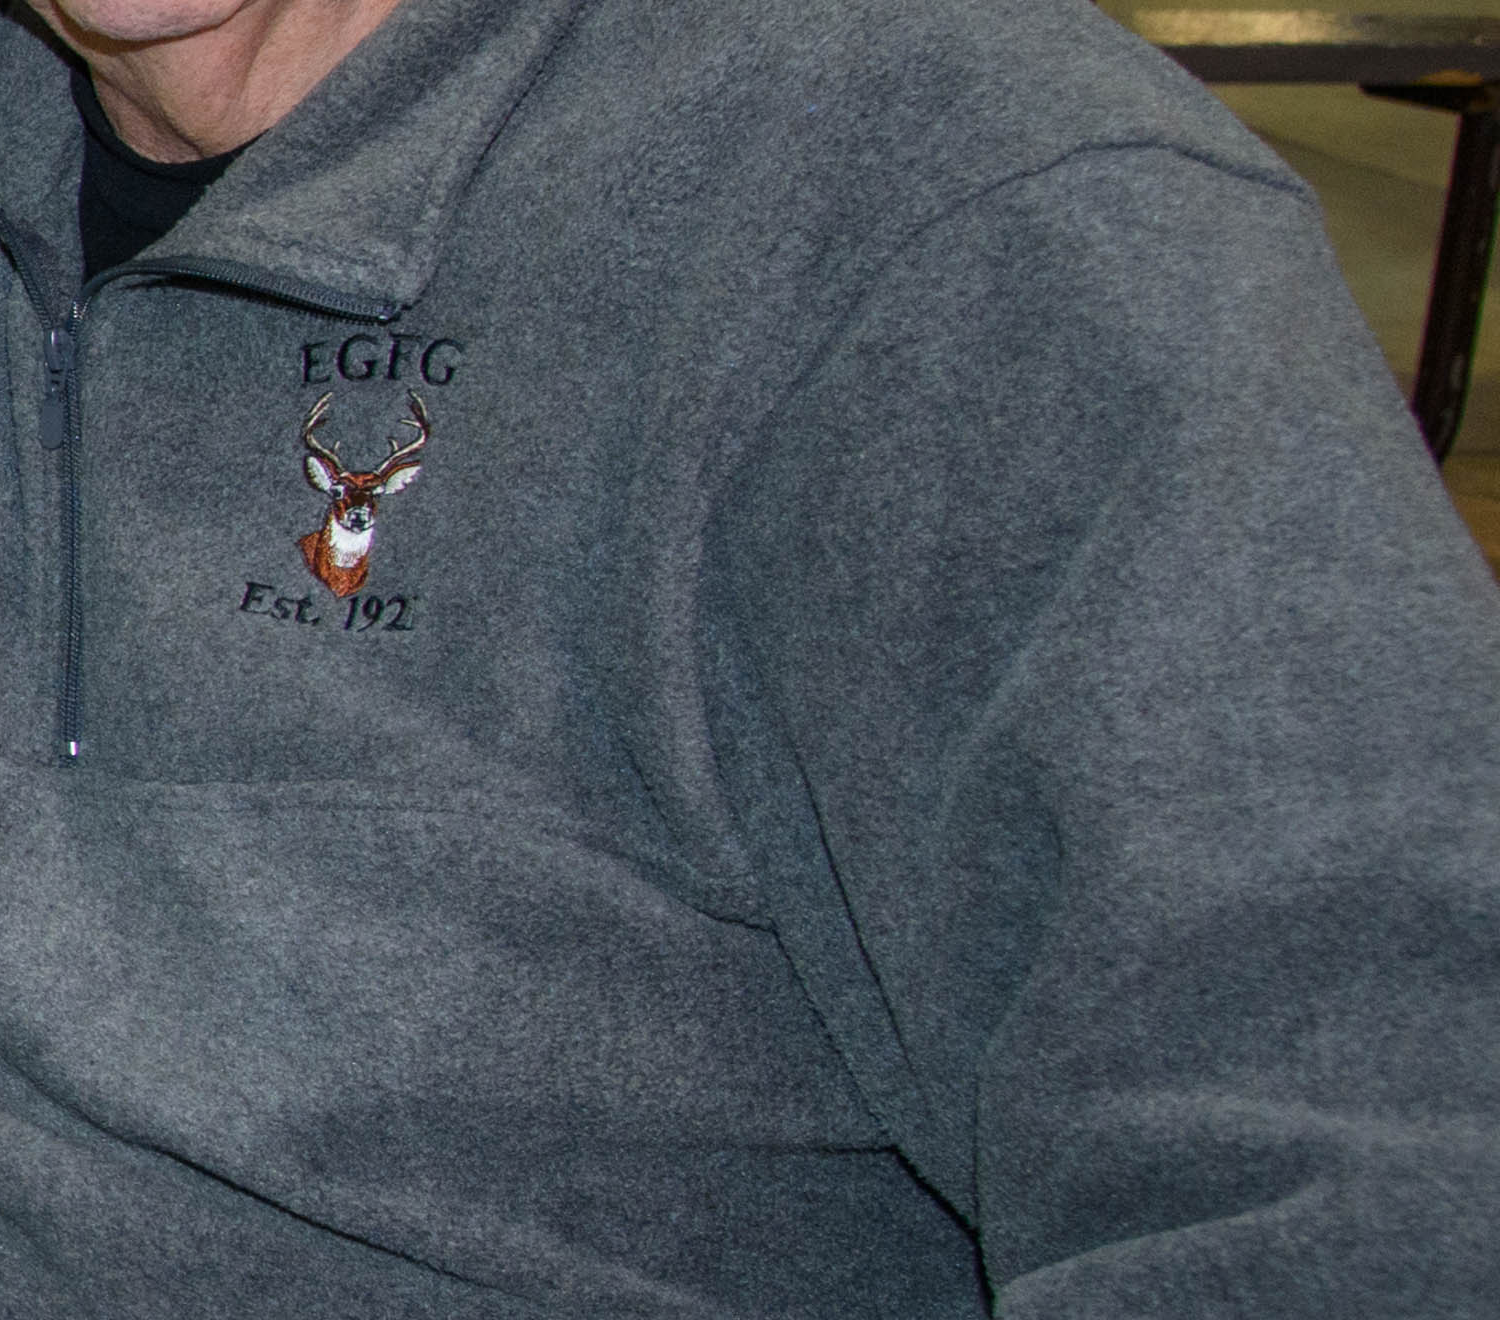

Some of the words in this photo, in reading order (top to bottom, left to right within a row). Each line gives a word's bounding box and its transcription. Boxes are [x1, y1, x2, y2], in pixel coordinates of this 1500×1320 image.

[301, 332, 466, 386] EGFG
[240, 581, 321, 626] Est.
[343, 593, 420, 632] 192
